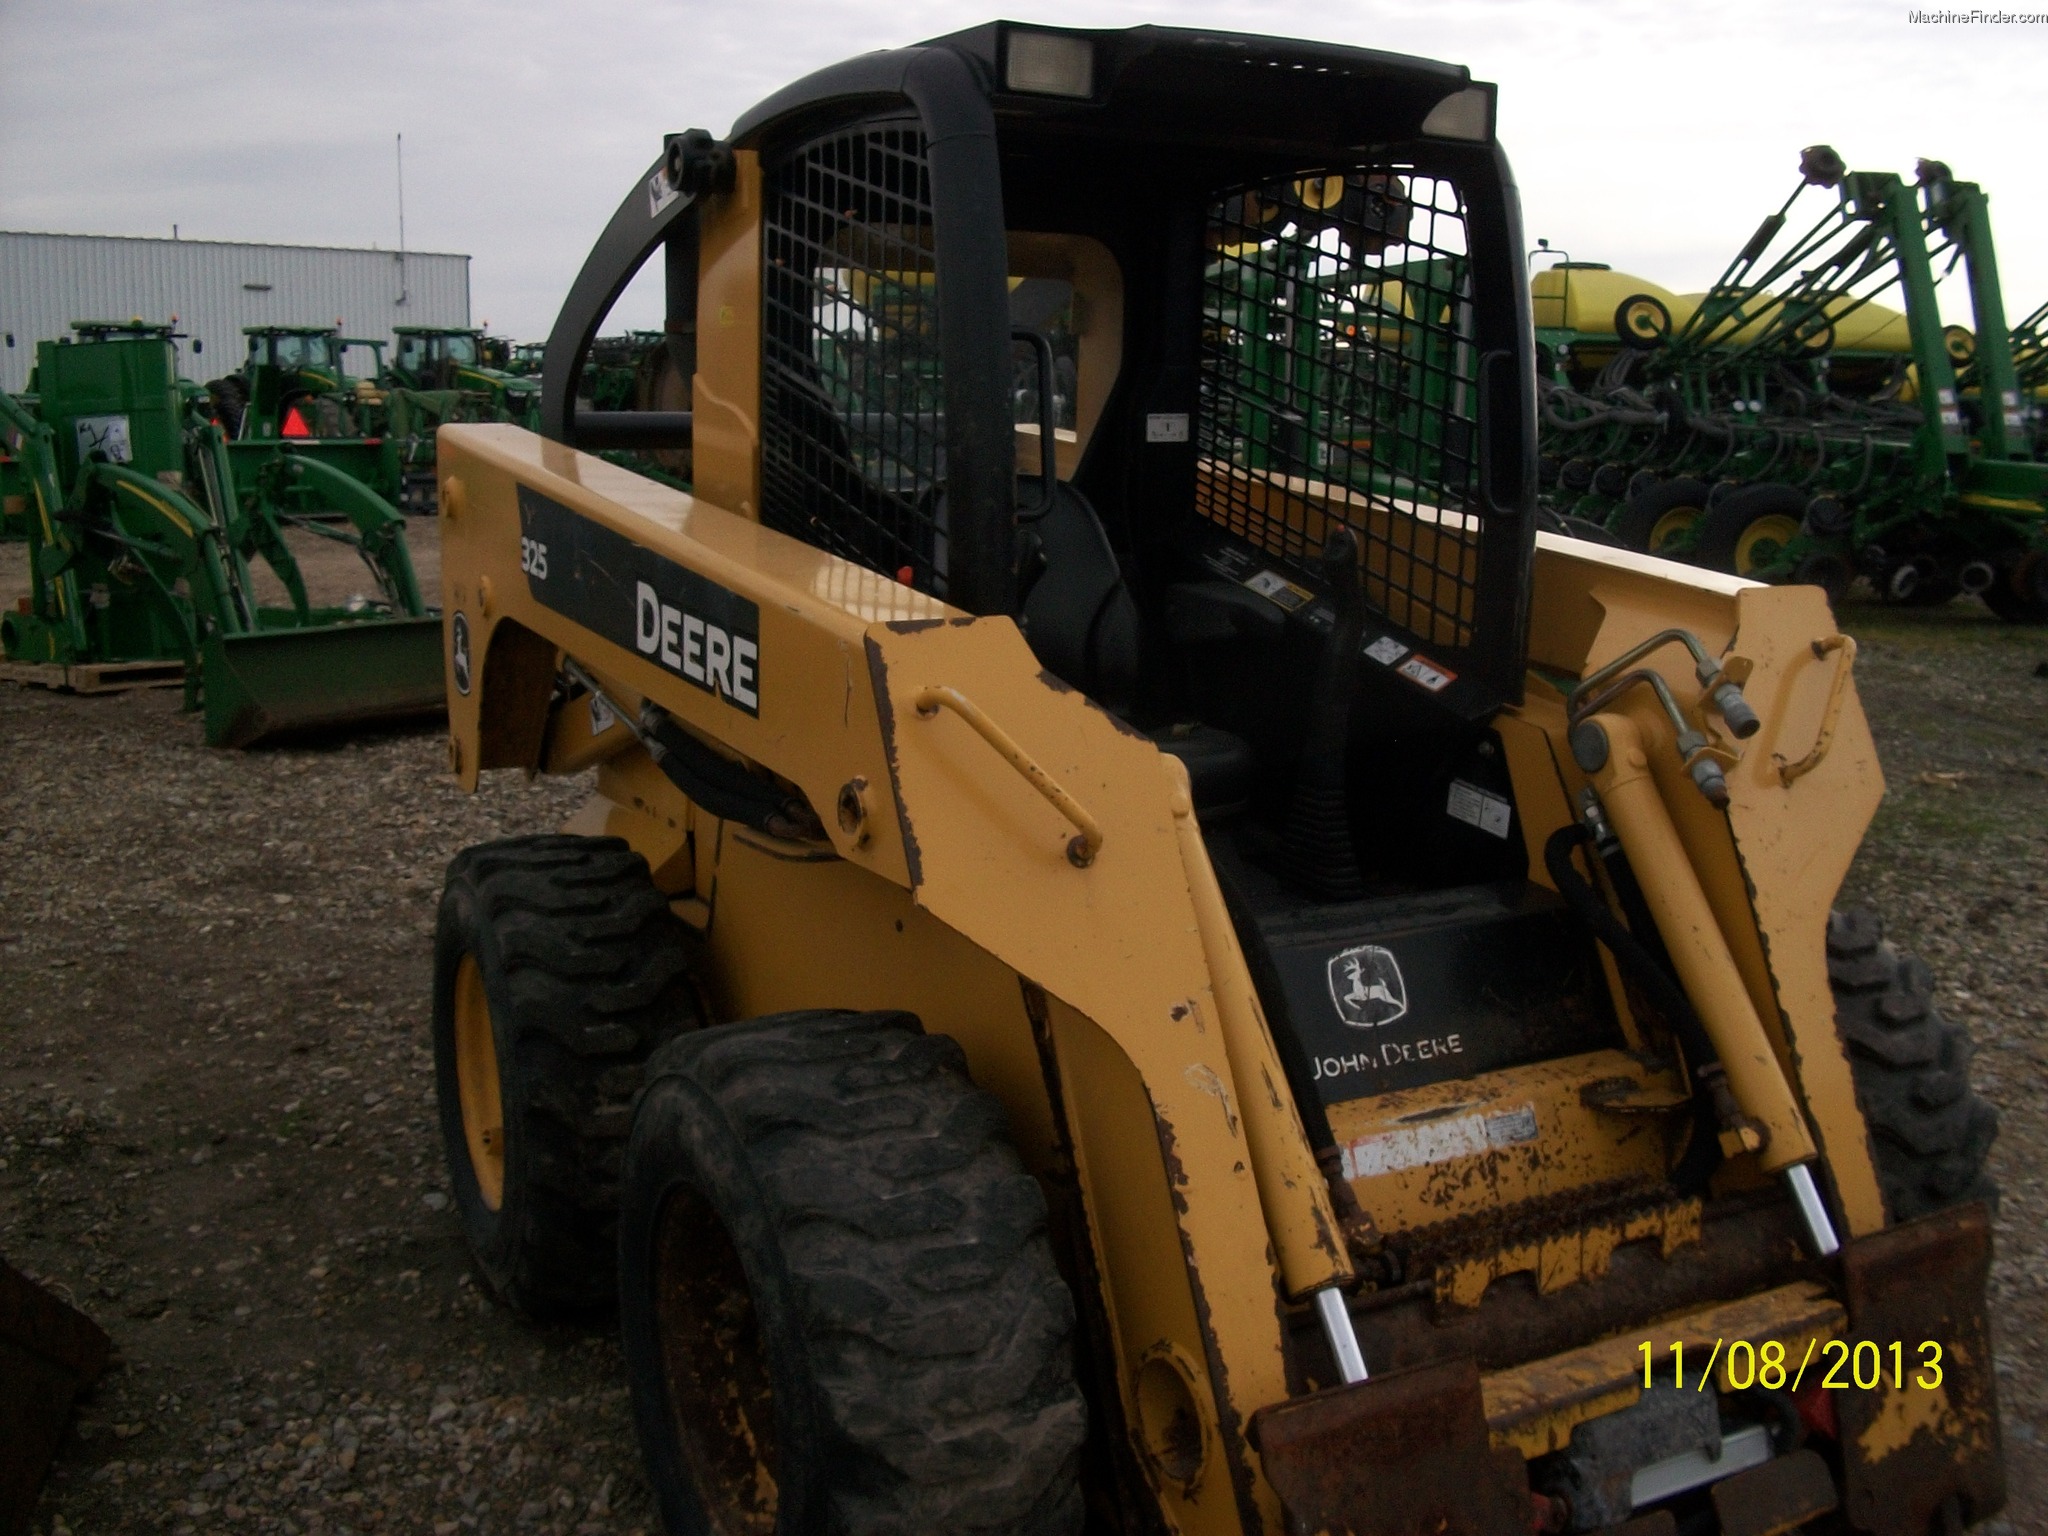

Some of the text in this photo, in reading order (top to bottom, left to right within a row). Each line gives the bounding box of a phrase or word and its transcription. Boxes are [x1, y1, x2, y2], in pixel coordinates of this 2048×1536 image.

[521, 536, 548, 580] 325
[636, 580, 758, 709] DEERE
[1313, 1033, 1464, 1080] JOHN DEERE
